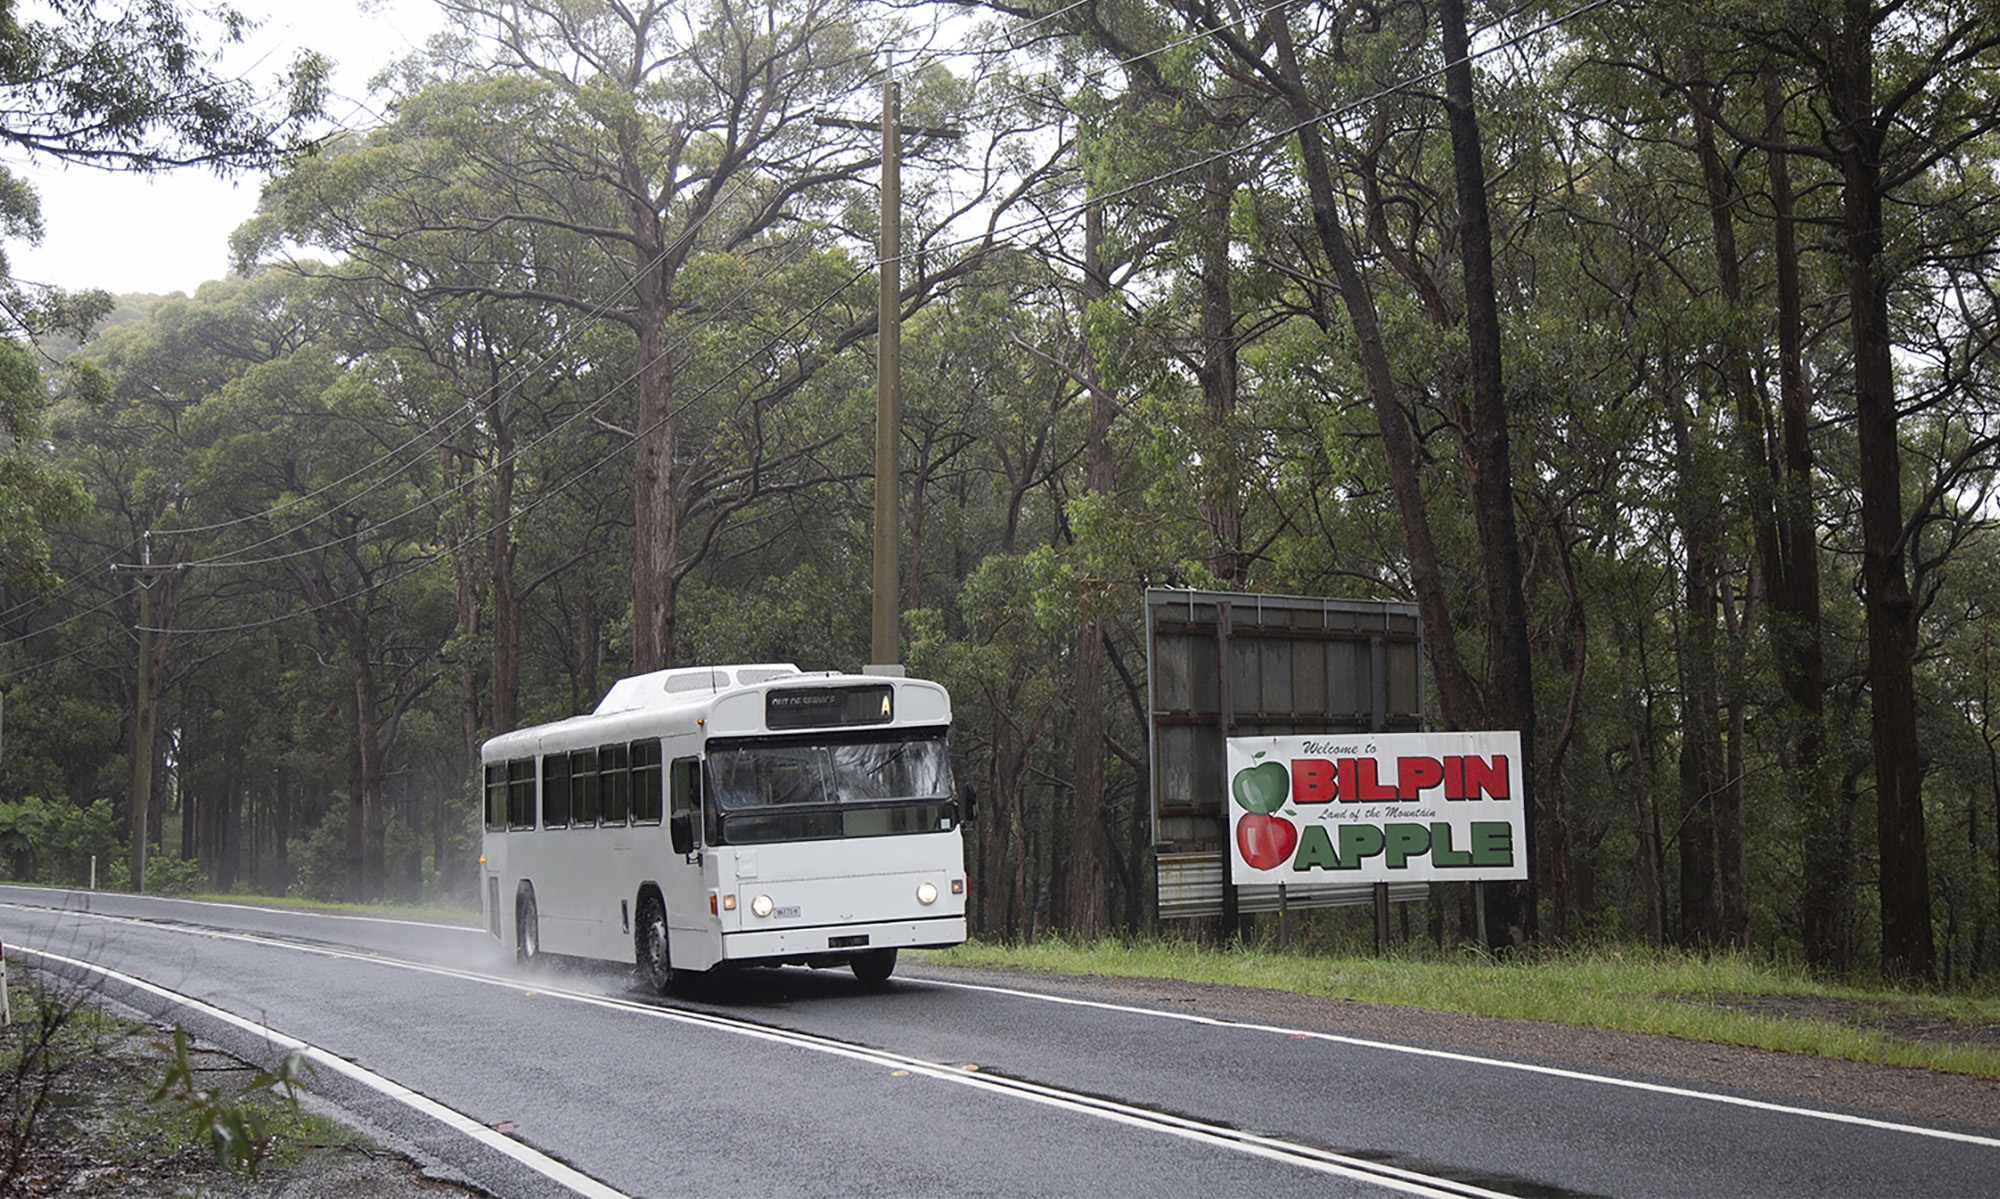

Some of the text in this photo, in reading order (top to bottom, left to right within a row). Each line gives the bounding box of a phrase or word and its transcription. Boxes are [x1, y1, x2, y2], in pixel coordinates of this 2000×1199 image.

[881, 695, 890, 716] A
[1302, 740, 1377, 754] Welcome to
[1291, 755, 1510, 804] BILPIN
[1318, 806, 1436, 822] Land of the Mountain
[1293, 822, 1513, 871] APPLE
